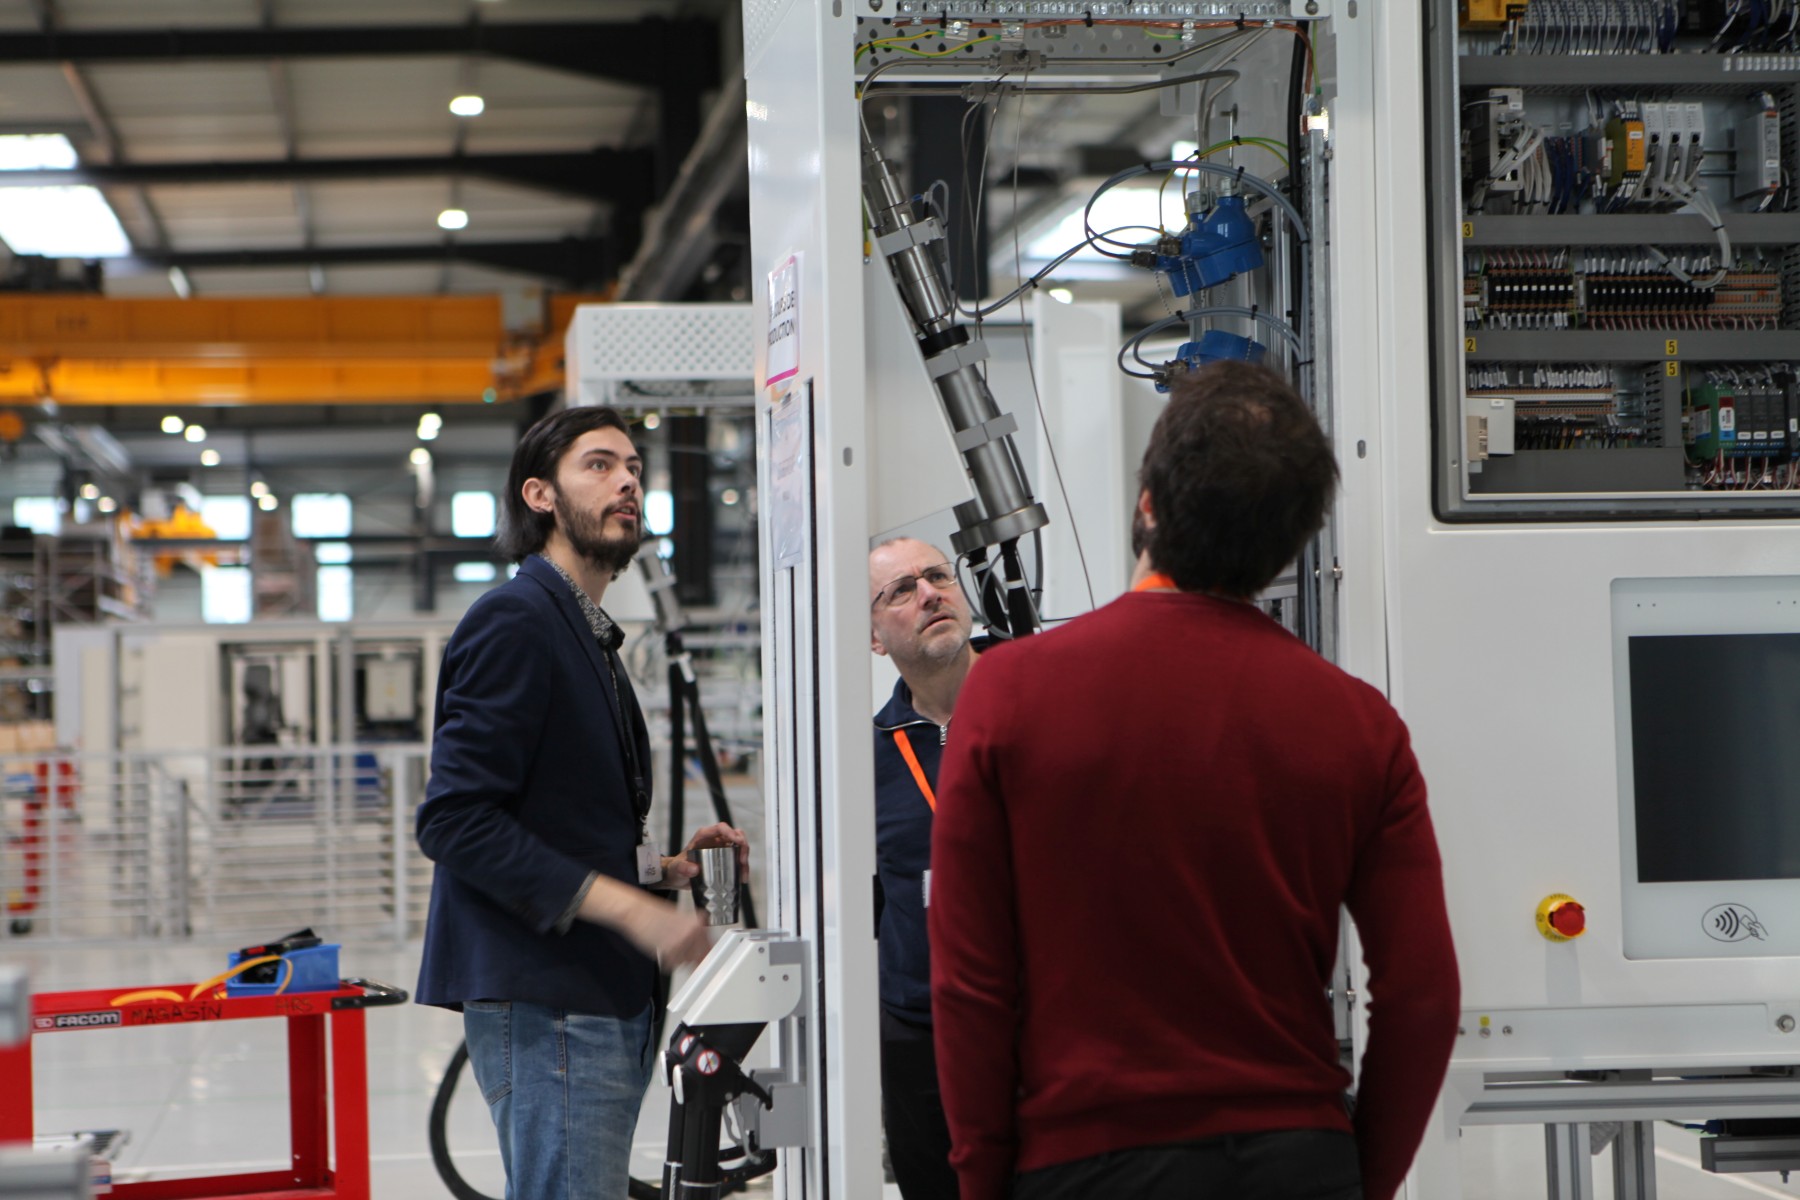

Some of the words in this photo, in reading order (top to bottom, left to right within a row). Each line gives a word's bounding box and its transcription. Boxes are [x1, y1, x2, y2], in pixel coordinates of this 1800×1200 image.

[1466, 338, 1474, 351] 2
[1668, 340, 1676, 354] 5
[1668, 361, 1676, 375] 5
[56, 1013, 119, 1027] FACOM
